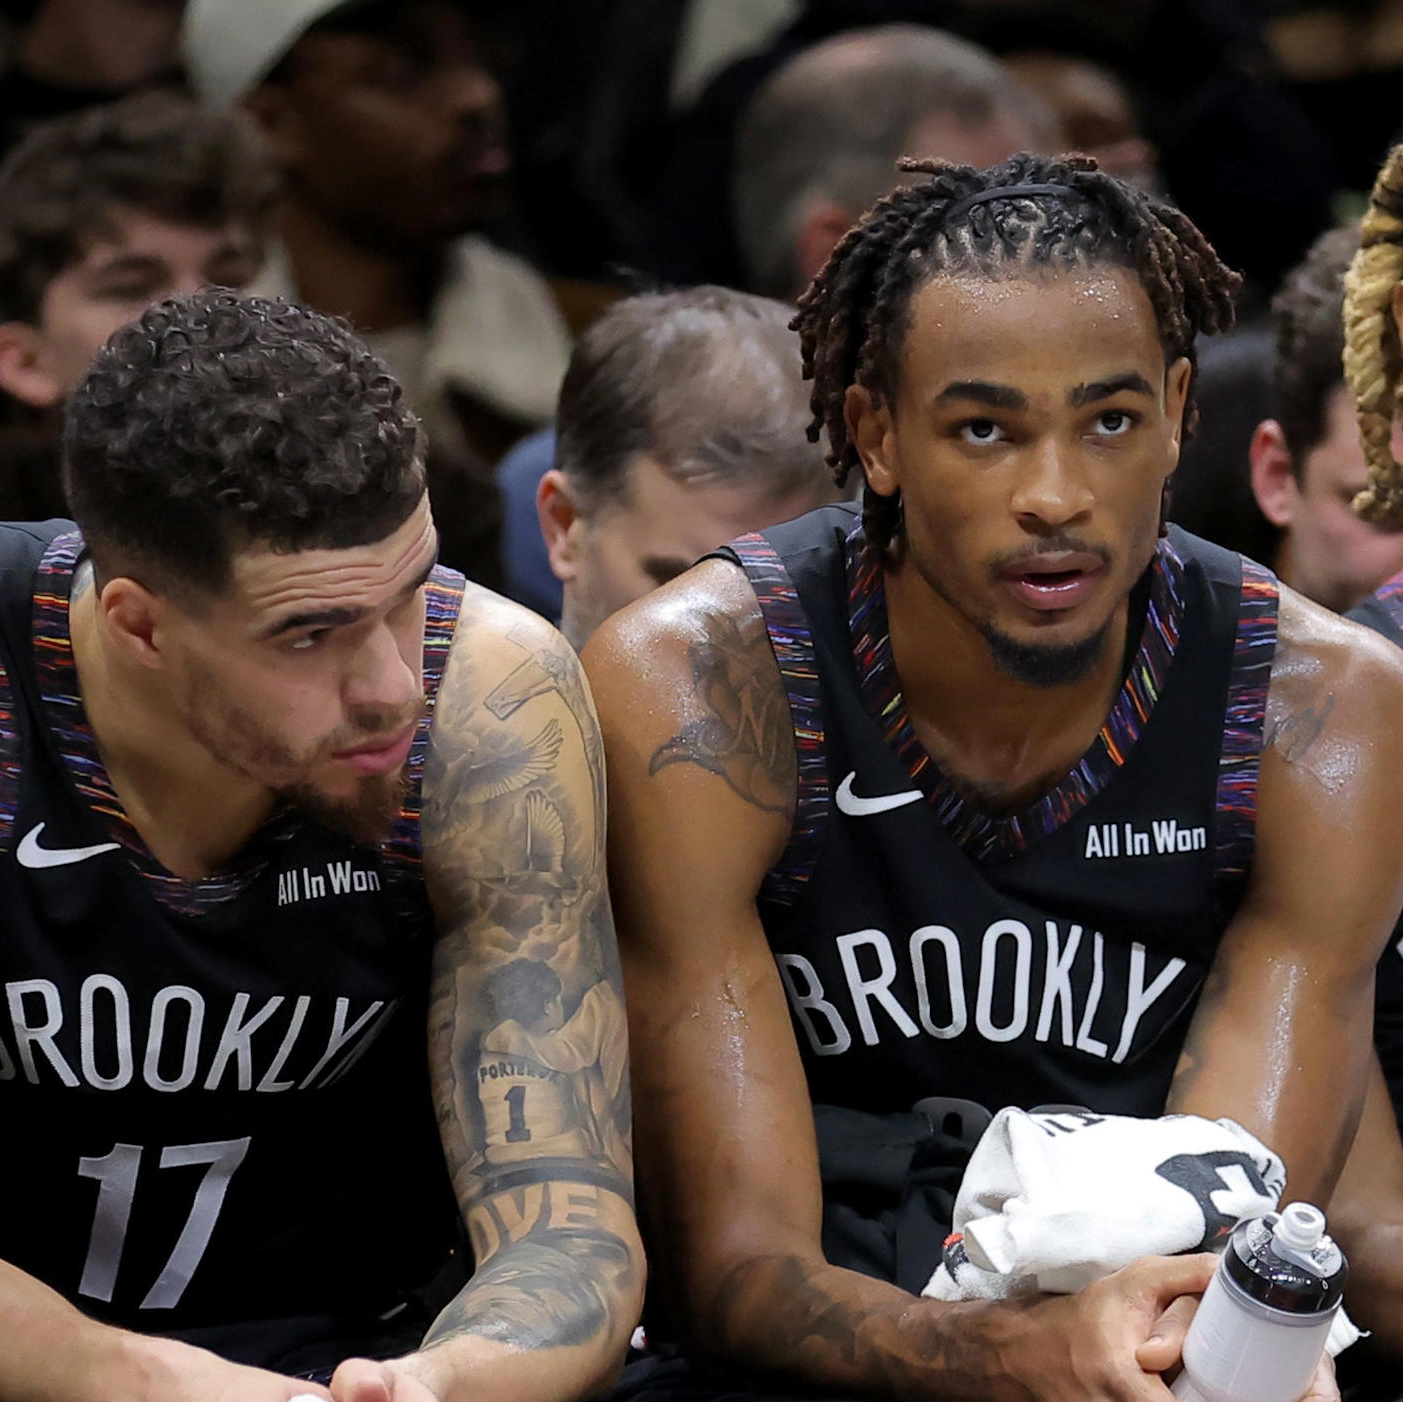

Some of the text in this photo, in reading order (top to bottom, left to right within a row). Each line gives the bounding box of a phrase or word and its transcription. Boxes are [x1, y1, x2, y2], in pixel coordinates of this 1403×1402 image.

[1085, 819, 1206, 858] All In Won
[278, 860, 381, 906] All In Won
[775, 918, 1188, 1064] BROOKLY
[503, 1084, 532, 1143] 1
[77, 1135, 253, 1310] 17
[466, 1180, 598, 1268] OVE
